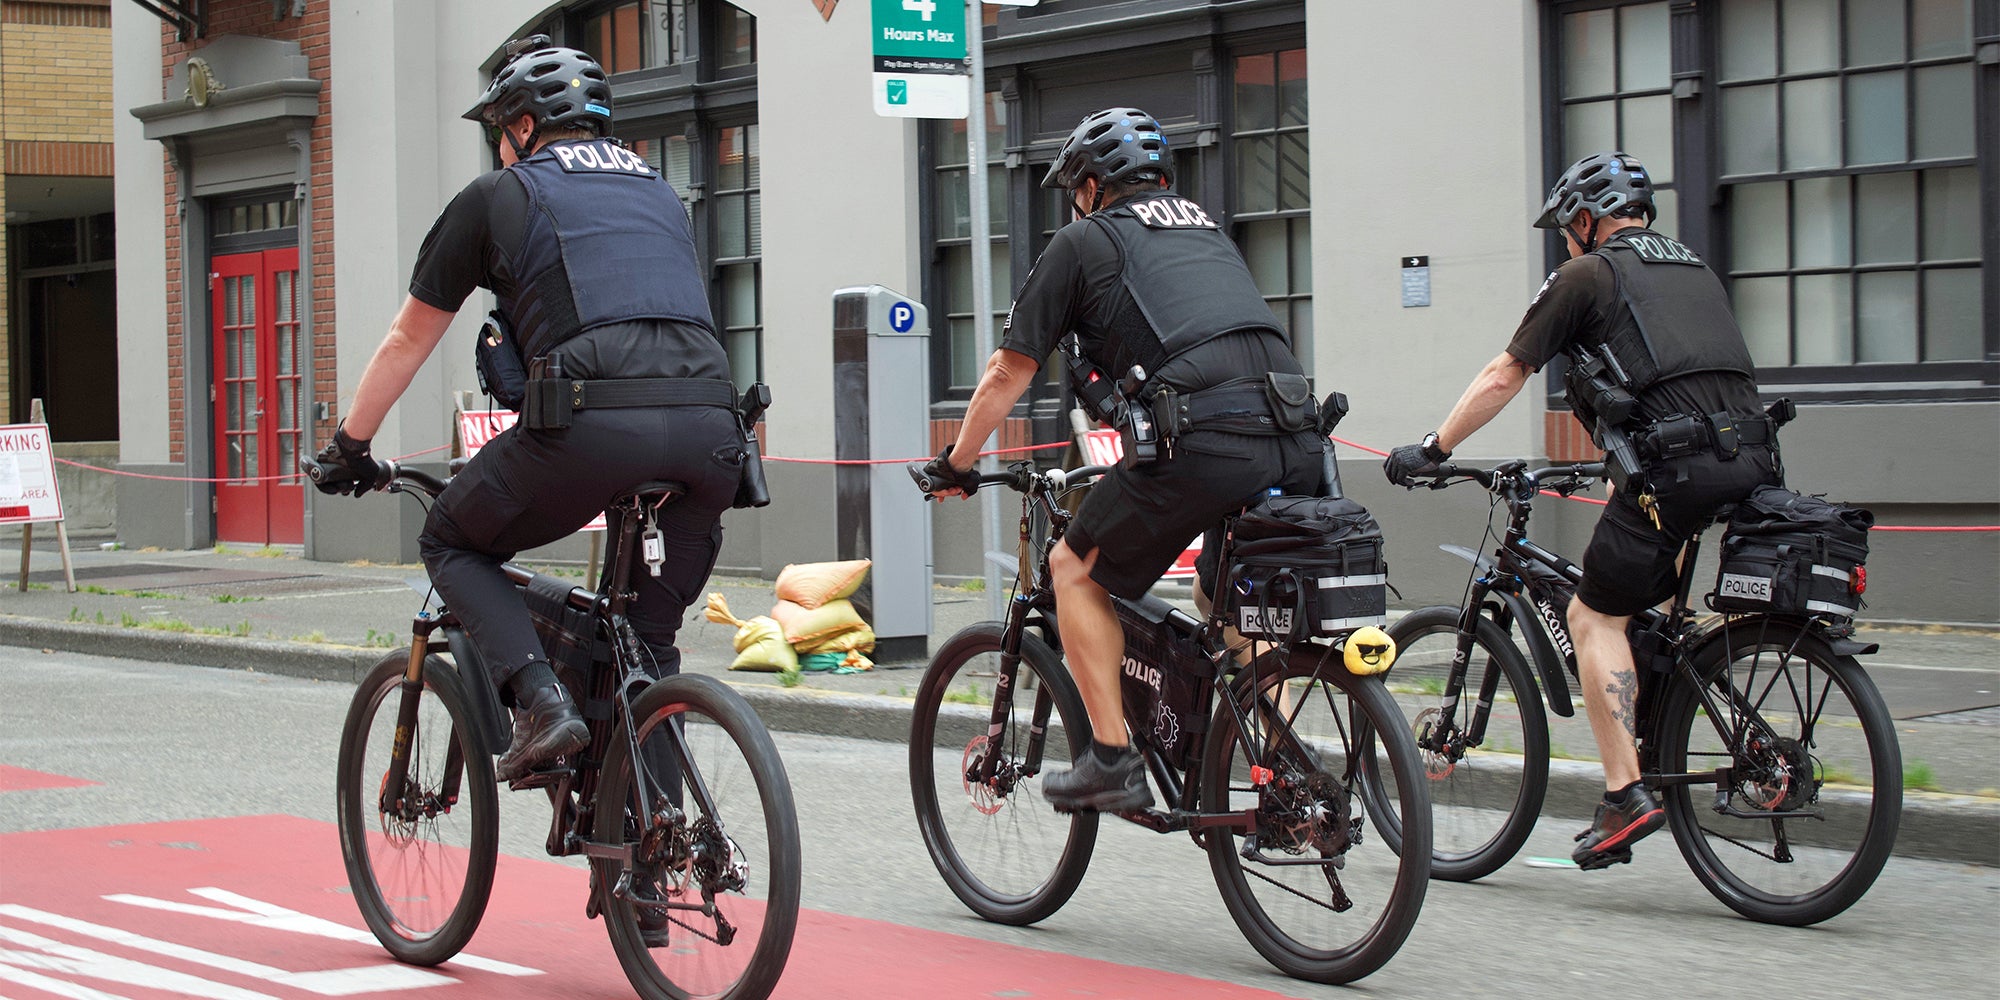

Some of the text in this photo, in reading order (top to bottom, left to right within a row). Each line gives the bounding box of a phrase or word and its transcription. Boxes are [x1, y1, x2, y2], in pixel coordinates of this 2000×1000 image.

[884, 28, 954, 43] Hours Max
[554, 143, 650, 174] POLICE
[1132, 199, 1216, 227] POLICE
[1628, 236, 1700, 262] POLICE
[895, 307, 911, 328] P
[21, 489, 49, 500] AREA
[1725, 580, 1768, 596] POLICE
[1246, 614, 1290, 629] POICE
